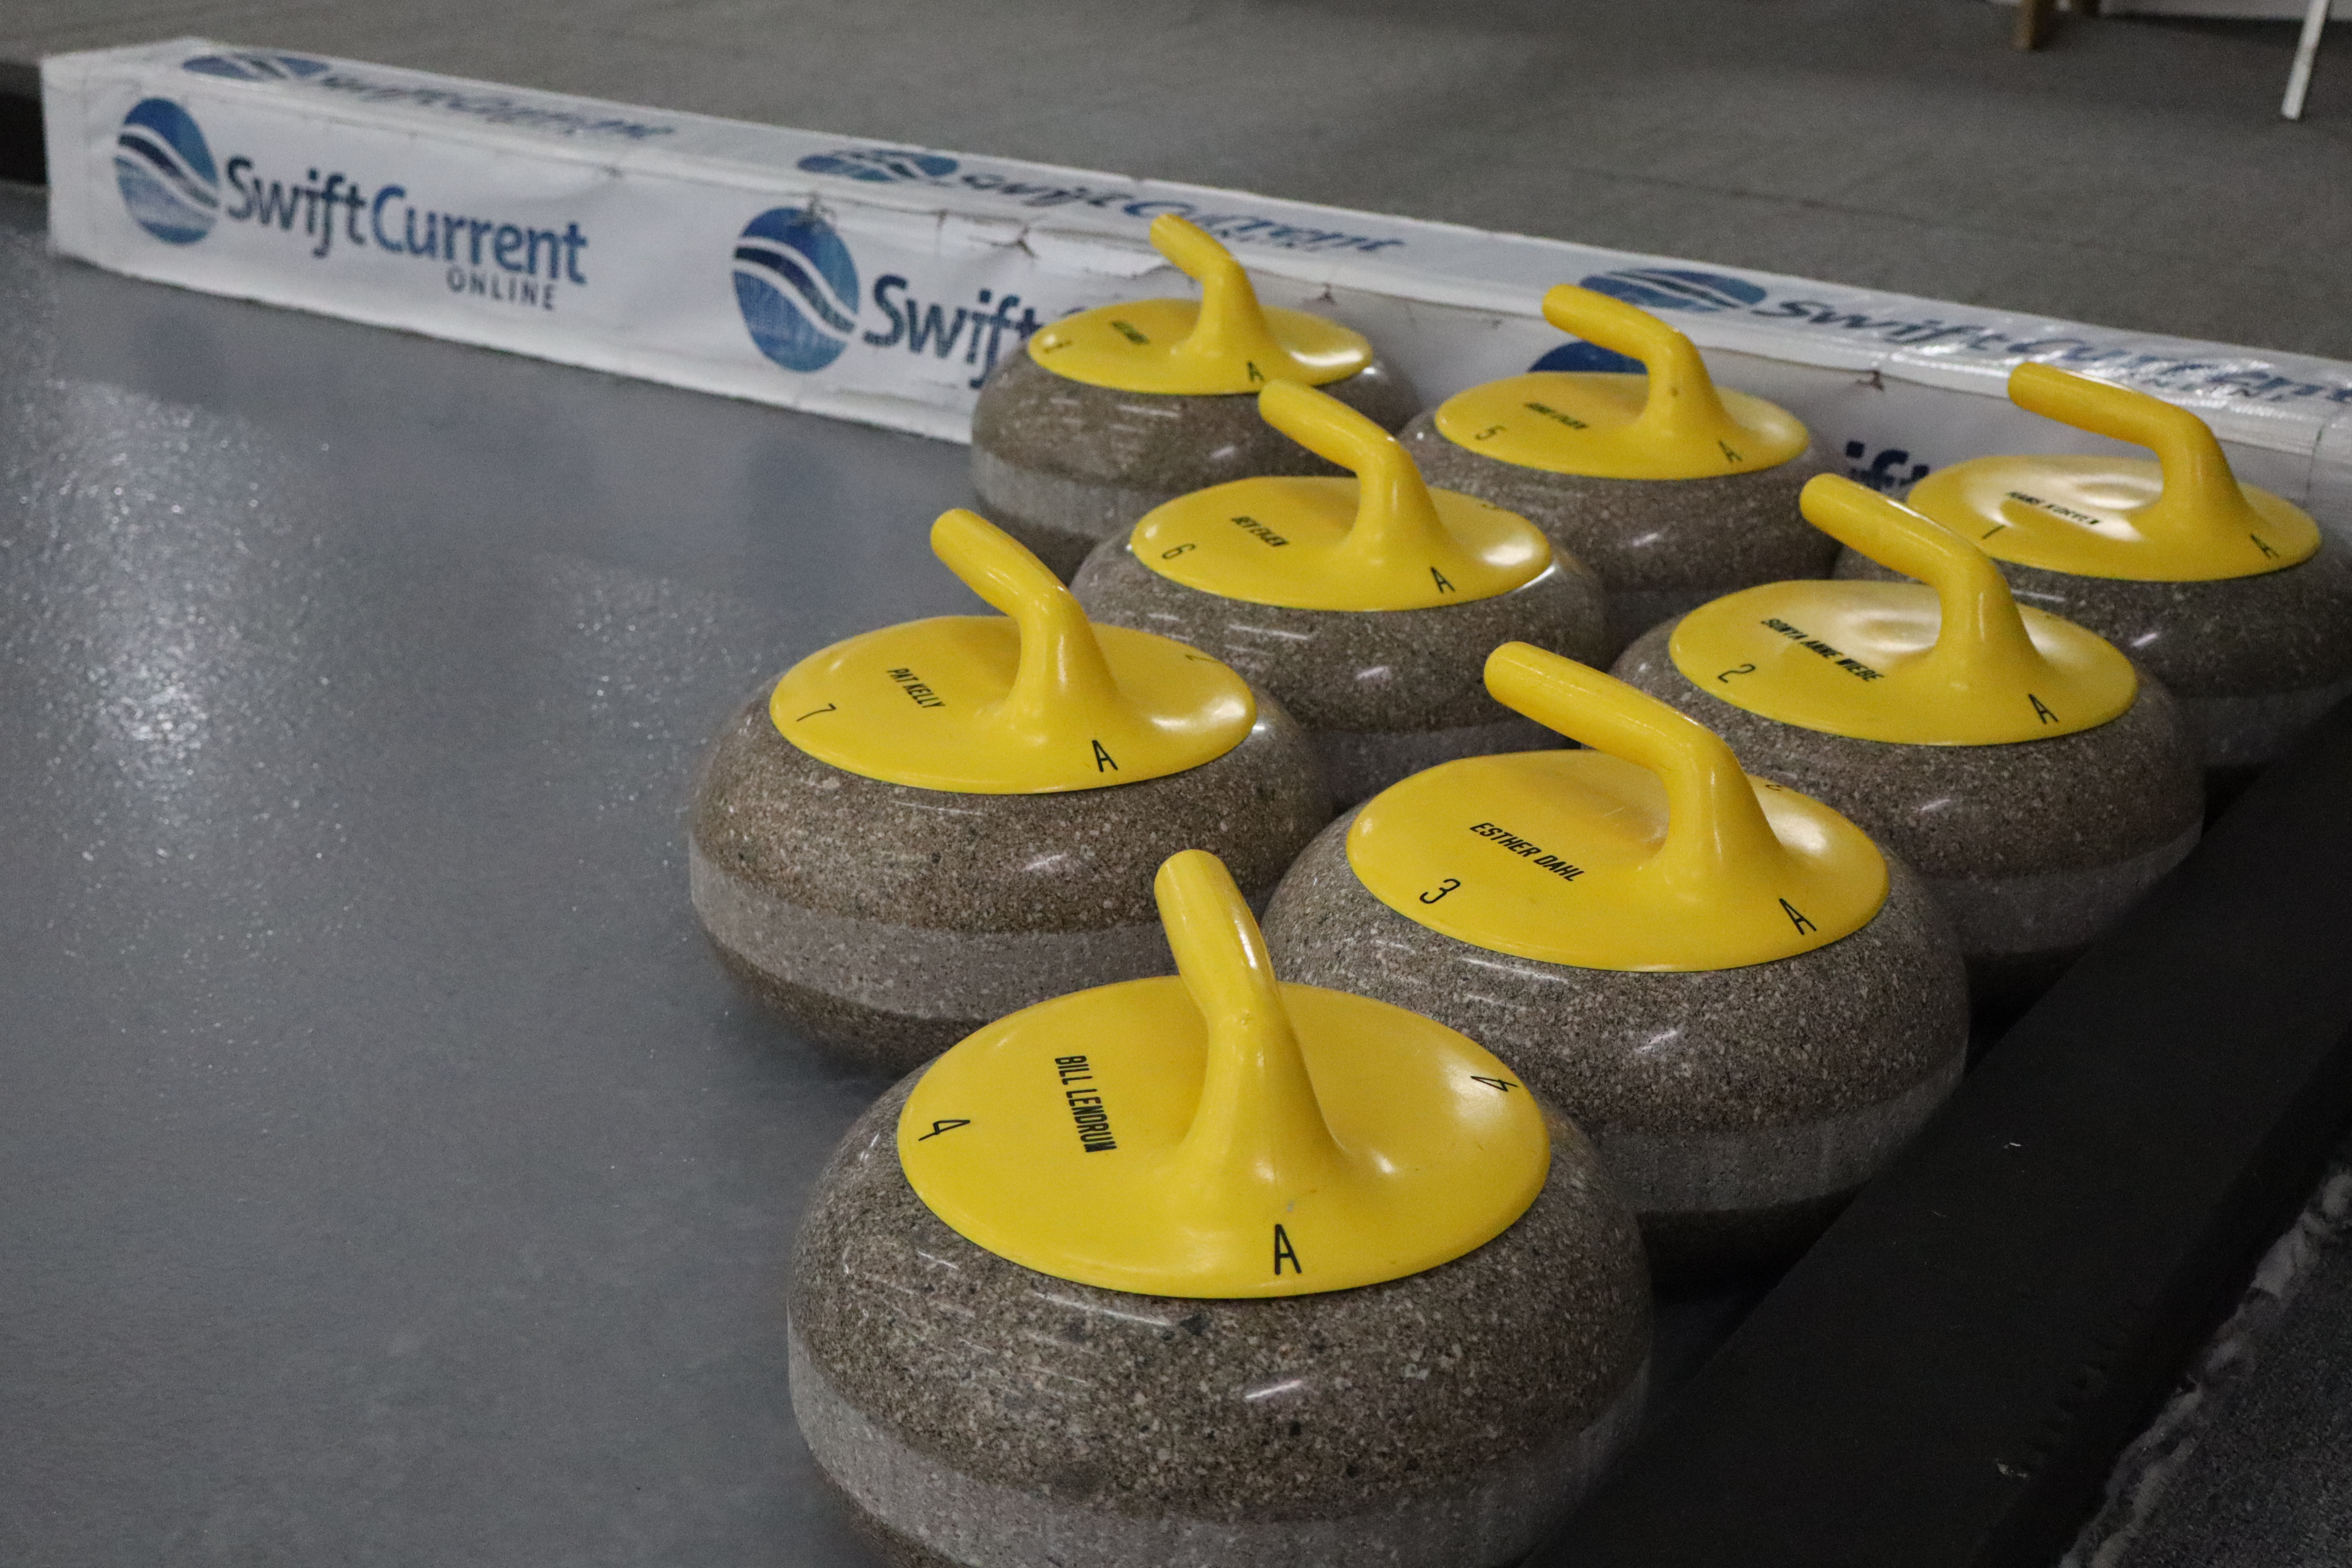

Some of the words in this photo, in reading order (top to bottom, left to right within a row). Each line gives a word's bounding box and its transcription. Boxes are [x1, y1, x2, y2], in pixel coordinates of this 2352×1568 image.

[226, 156, 589, 285] SwiftCurrent
[446, 264, 556, 311] ONLINE
[1247, 359, 1265, 383] A
[1474, 425, 1506, 441] 5
[1719, 440, 1742, 463] A
[1162, 543, 1196, 560] 6
[2250, 534, 2279, 559] A
[1430, 566, 1455, 594] A
[886, 668, 919, 682] PAT
[1718, 663, 1756, 683] 2
[902, 682, 946, 708] KELLY
[796, 703, 837, 722] 7
[2028, 693, 2059, 724] A
[1092, 739, 1118, 773] A
[1469, 822, 1542, 857] ESTHER
[1533, 855, 1585, 882] DAHL
[1419, 878, 1461, 904] 3
[1779, 898, 1817, 935] A
[1054, 1055, 1093, 1085] BILL
[1470, 1075, 1519, 1092] 4
[918, 1119, 971, 1142] 4
[1066, 1088, 1117, 1153] LENDRUM
[1274, 1223, 1303, 1276] A
